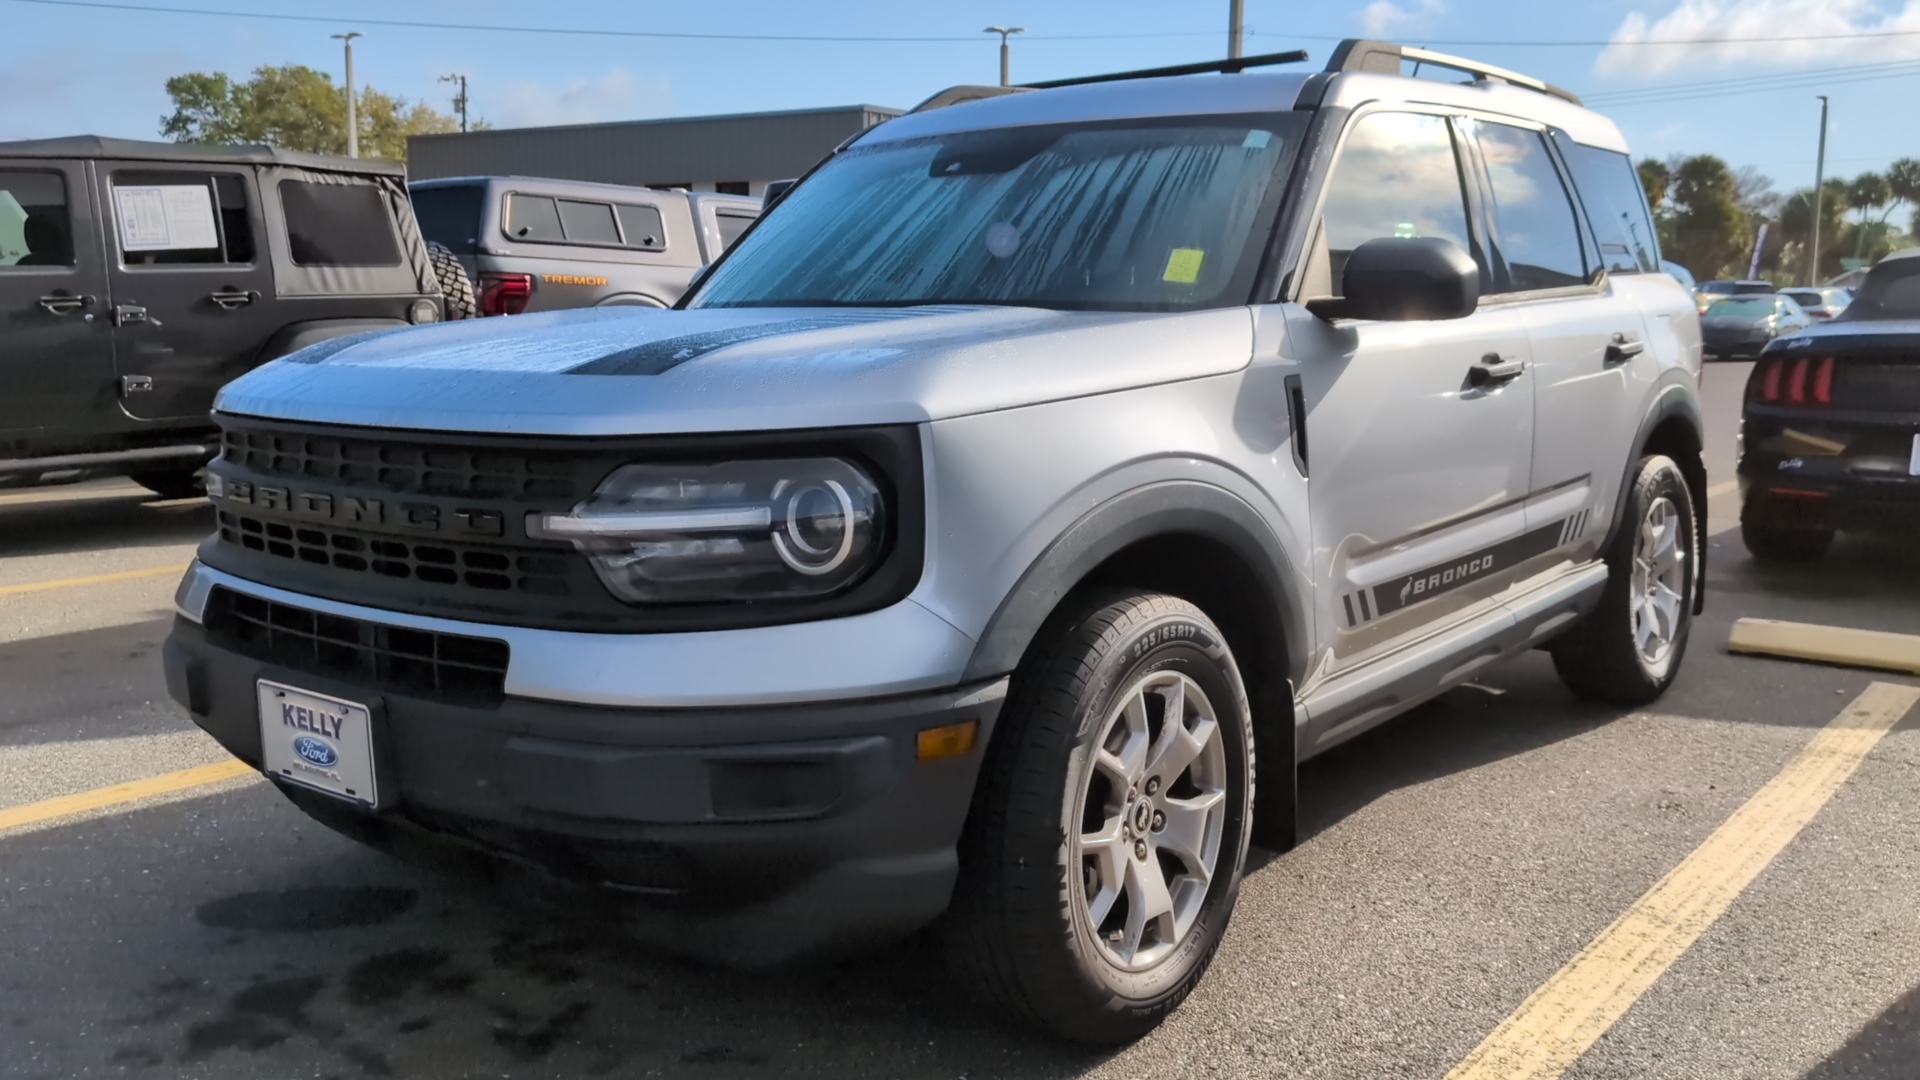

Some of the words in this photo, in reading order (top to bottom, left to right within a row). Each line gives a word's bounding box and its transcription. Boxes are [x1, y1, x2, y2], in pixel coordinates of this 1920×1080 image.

[542, 273, 608, 287] TREMOR
[1412, 554, 1493, 595] BRONCO
[1134, 626, 1196, 659] 225/65R17
[282, 702, 343, 740] KELLY
[301, 738, 329, 762] Ford
